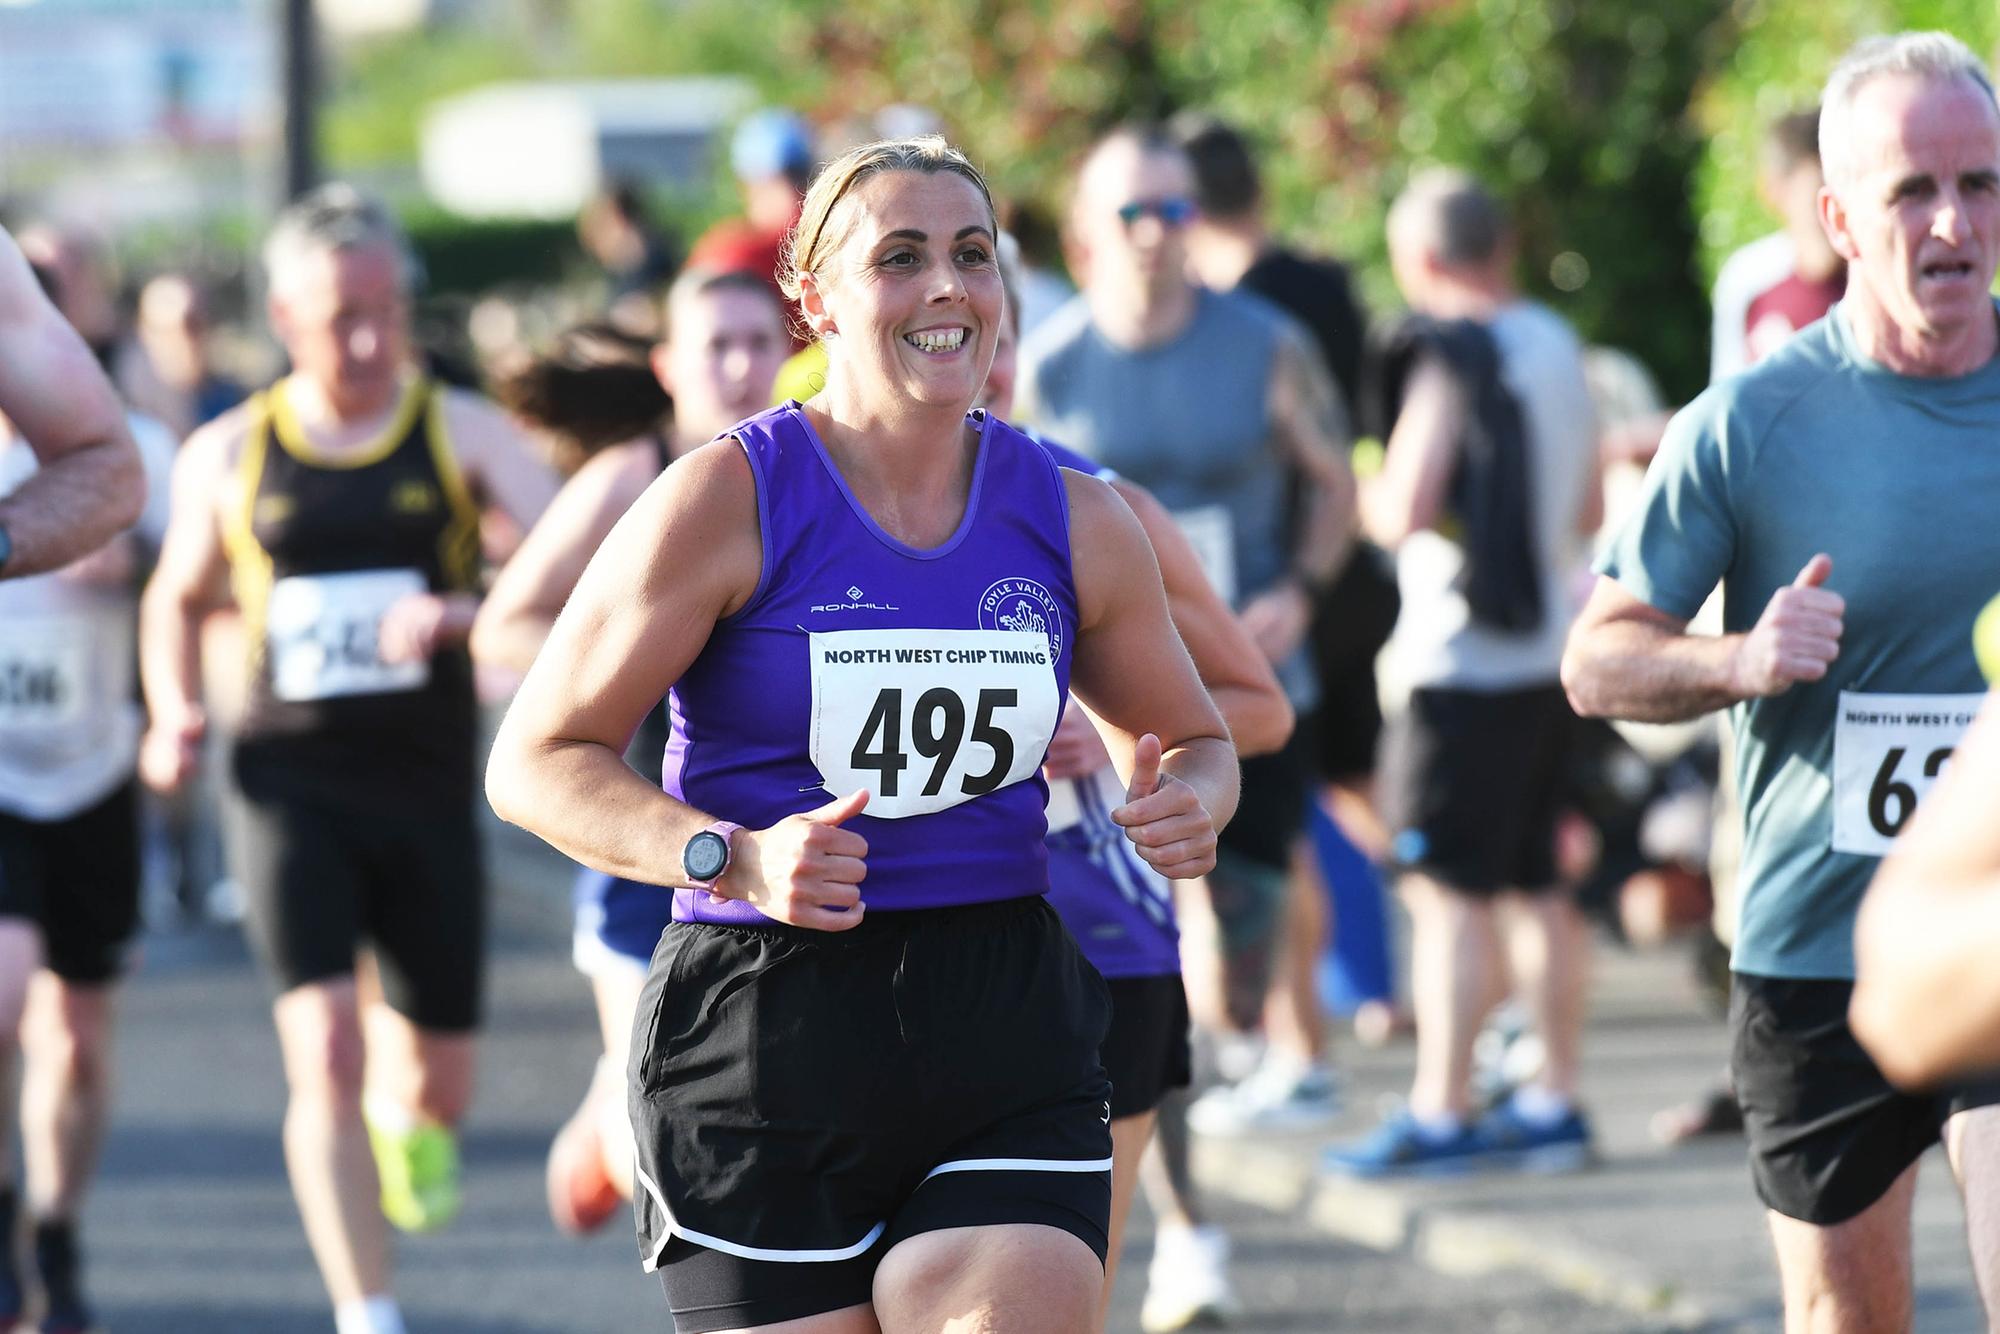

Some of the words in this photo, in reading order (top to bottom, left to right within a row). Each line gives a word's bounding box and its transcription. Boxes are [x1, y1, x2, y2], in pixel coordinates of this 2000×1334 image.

[984, 583, 1012, 612] FOYLE
[1016, 582, 1055, 612] VALLEY
[811, 603, 899, 613] RONHILL
[824, 649, 891, 664] NORTH
[895, 649, 943, 664] WEST
[946, 649, 987, 664] CHIP
[989, 649, 1047, 665] TIMING
[1845, 710, 1902, 725] NORTH
[1906, 711, 1950, 726] WEST
[850, 687, 1018, 797] 495
